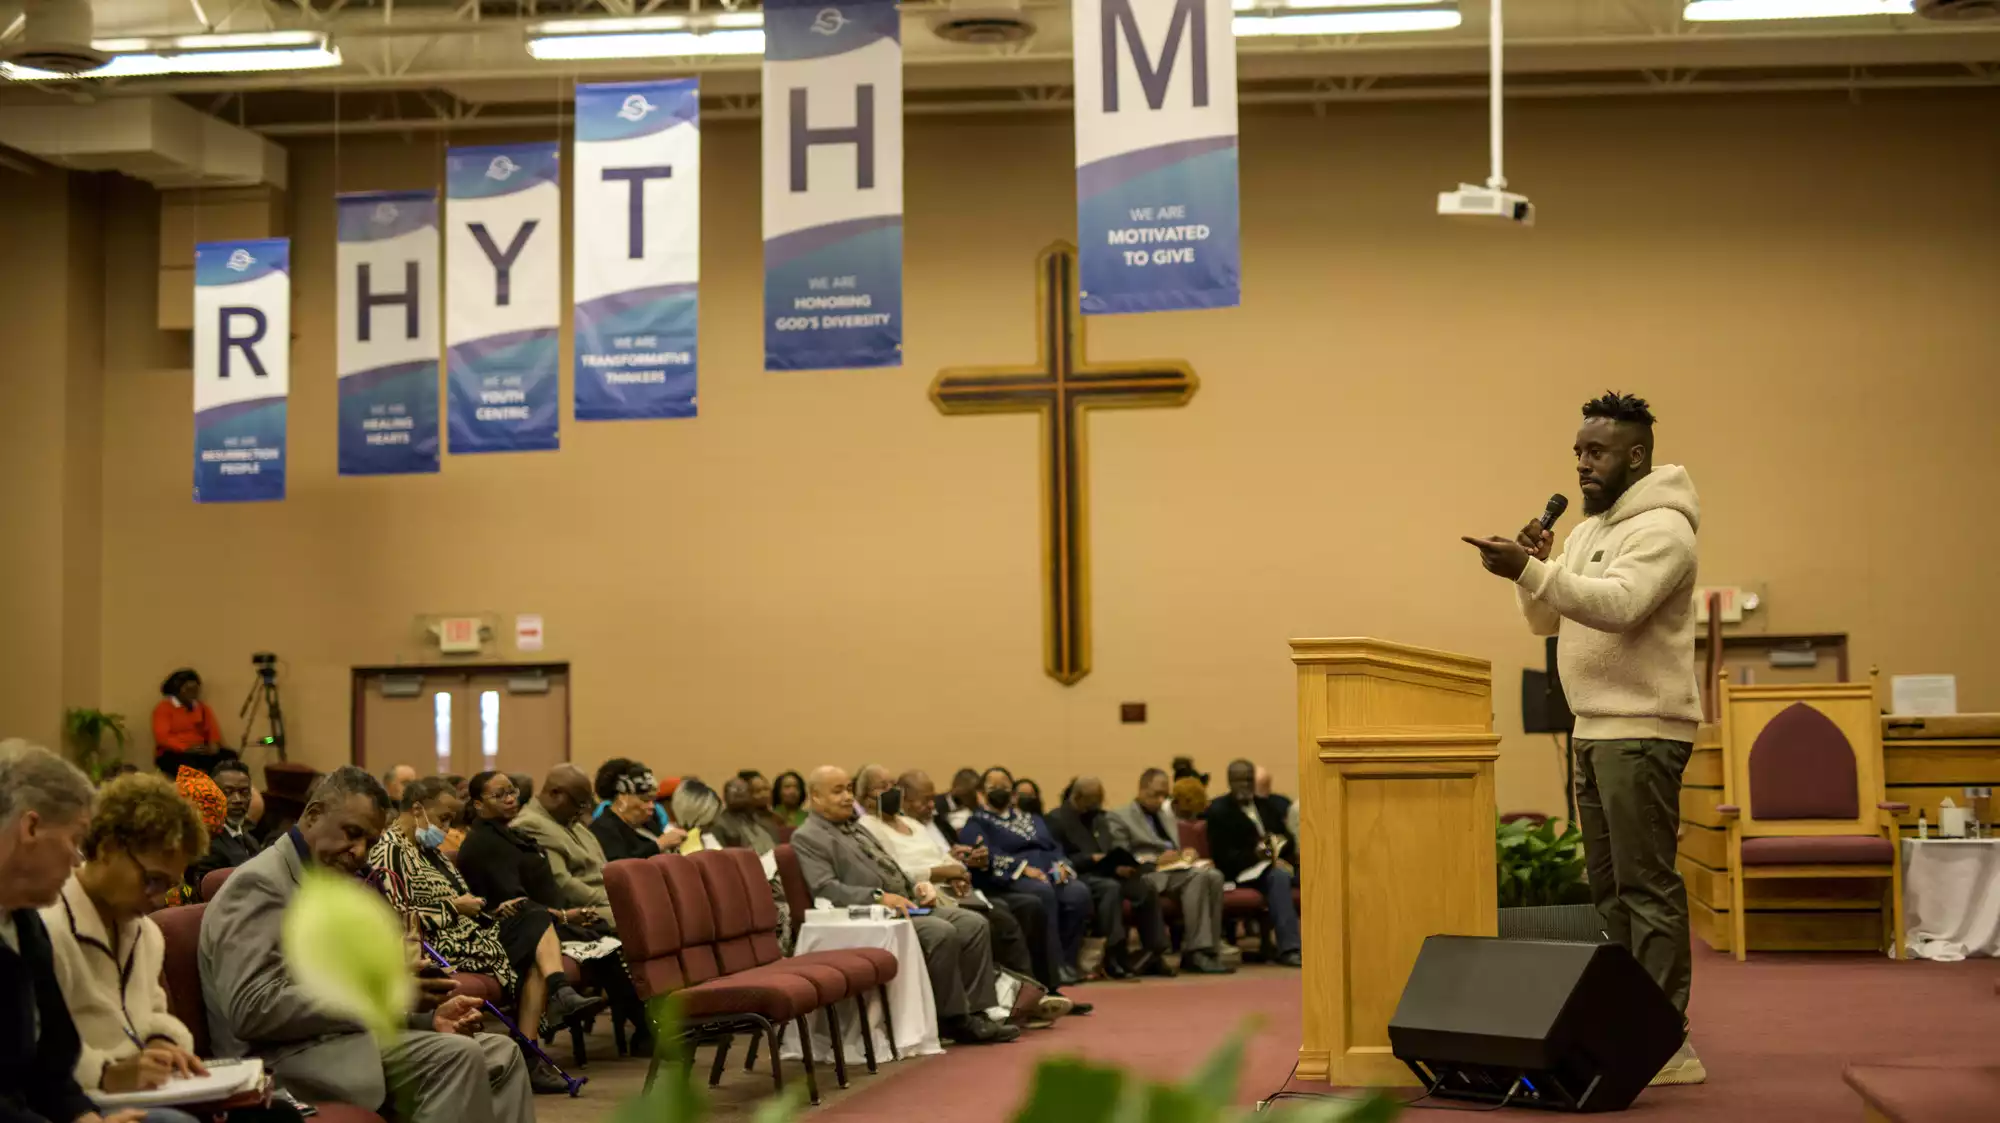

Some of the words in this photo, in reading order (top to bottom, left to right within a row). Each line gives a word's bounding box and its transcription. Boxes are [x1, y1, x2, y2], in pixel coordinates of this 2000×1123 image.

[1101, 0, 1209, 112] M
[790, 83, 874, 192] H
[601, 165, 672, 259] T
[1108, 225, 1210, 245] MOTIVATED
[1129, 207, 1154, 221] WE
[1157, 205, 1186, 220] ARE
[465, 219, 541, 306] Y
[1123, 250, 1149, 266] TO
[1152, 247, 1195, 265] GIVE
[357, 261, 419, 341] H
[775, 316, 819, 331] GOD'S
[822, 313, 890, 329] DIVERSITY
[794, 294, 872, 310] HONORING
[219, 306, 268, 377] R
